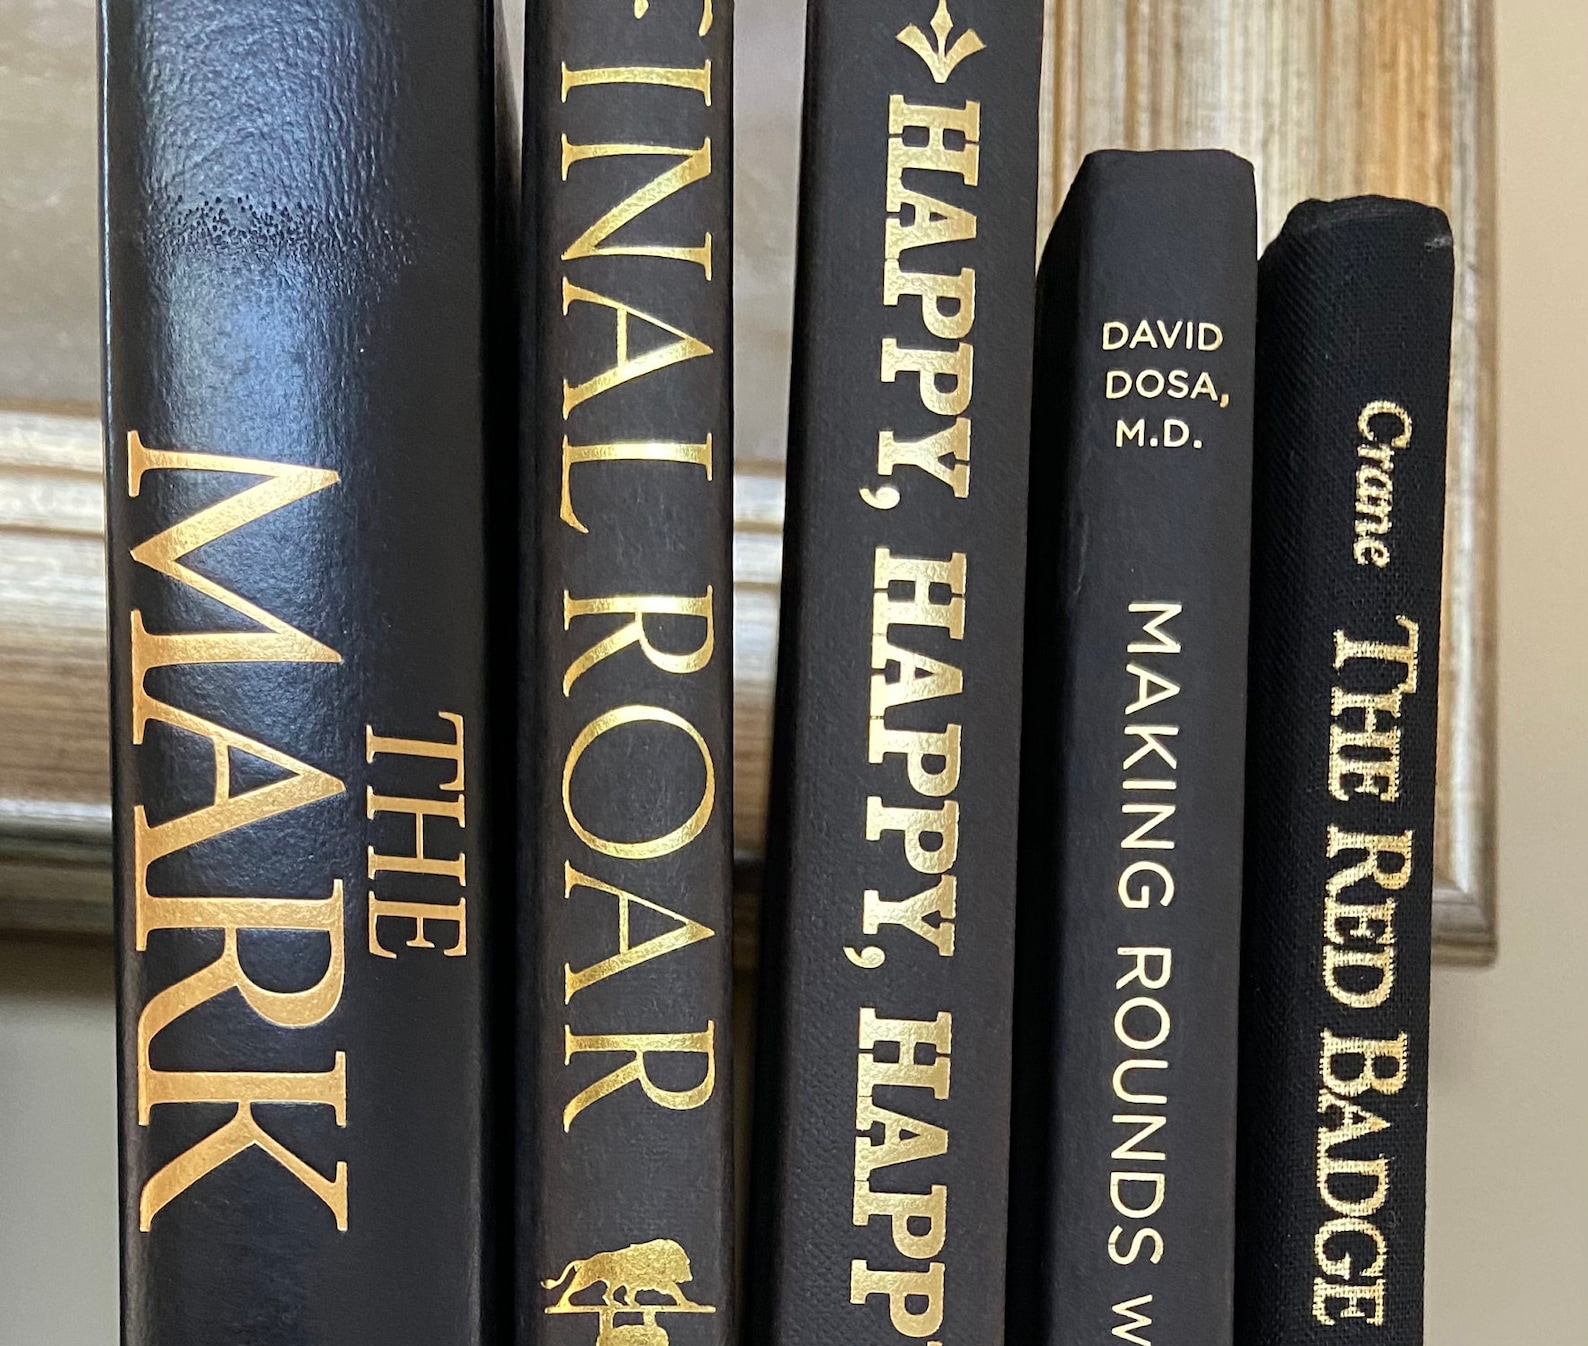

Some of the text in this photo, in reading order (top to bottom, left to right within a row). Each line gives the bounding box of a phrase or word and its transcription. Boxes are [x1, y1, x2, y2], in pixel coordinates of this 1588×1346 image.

[859, 94, 981, 511] HAPPY,
[1101, 320, 1223, 351] DAVID
[1105, 369, 1230, 408] DOSA,
[1115, 419, 1204, 449] M.D.
[560, 0, 715, 1134] INAL ROAR
[1353, 399, 1413, 568] Crane
[127, 430, 348, 1232] MARK
[365, 710, 467, 959] THE
[843, 547, 968, 970] HAPPY,
[1117, 601, 1183, 910] MAKING
[1327, 614, 1420, 803] THE
[1321, 825, 1414, 1009] RED
[1108, 946, 1173, 1266] ROUNDS
[1312, 1027, 1410, 1326] BADGE
